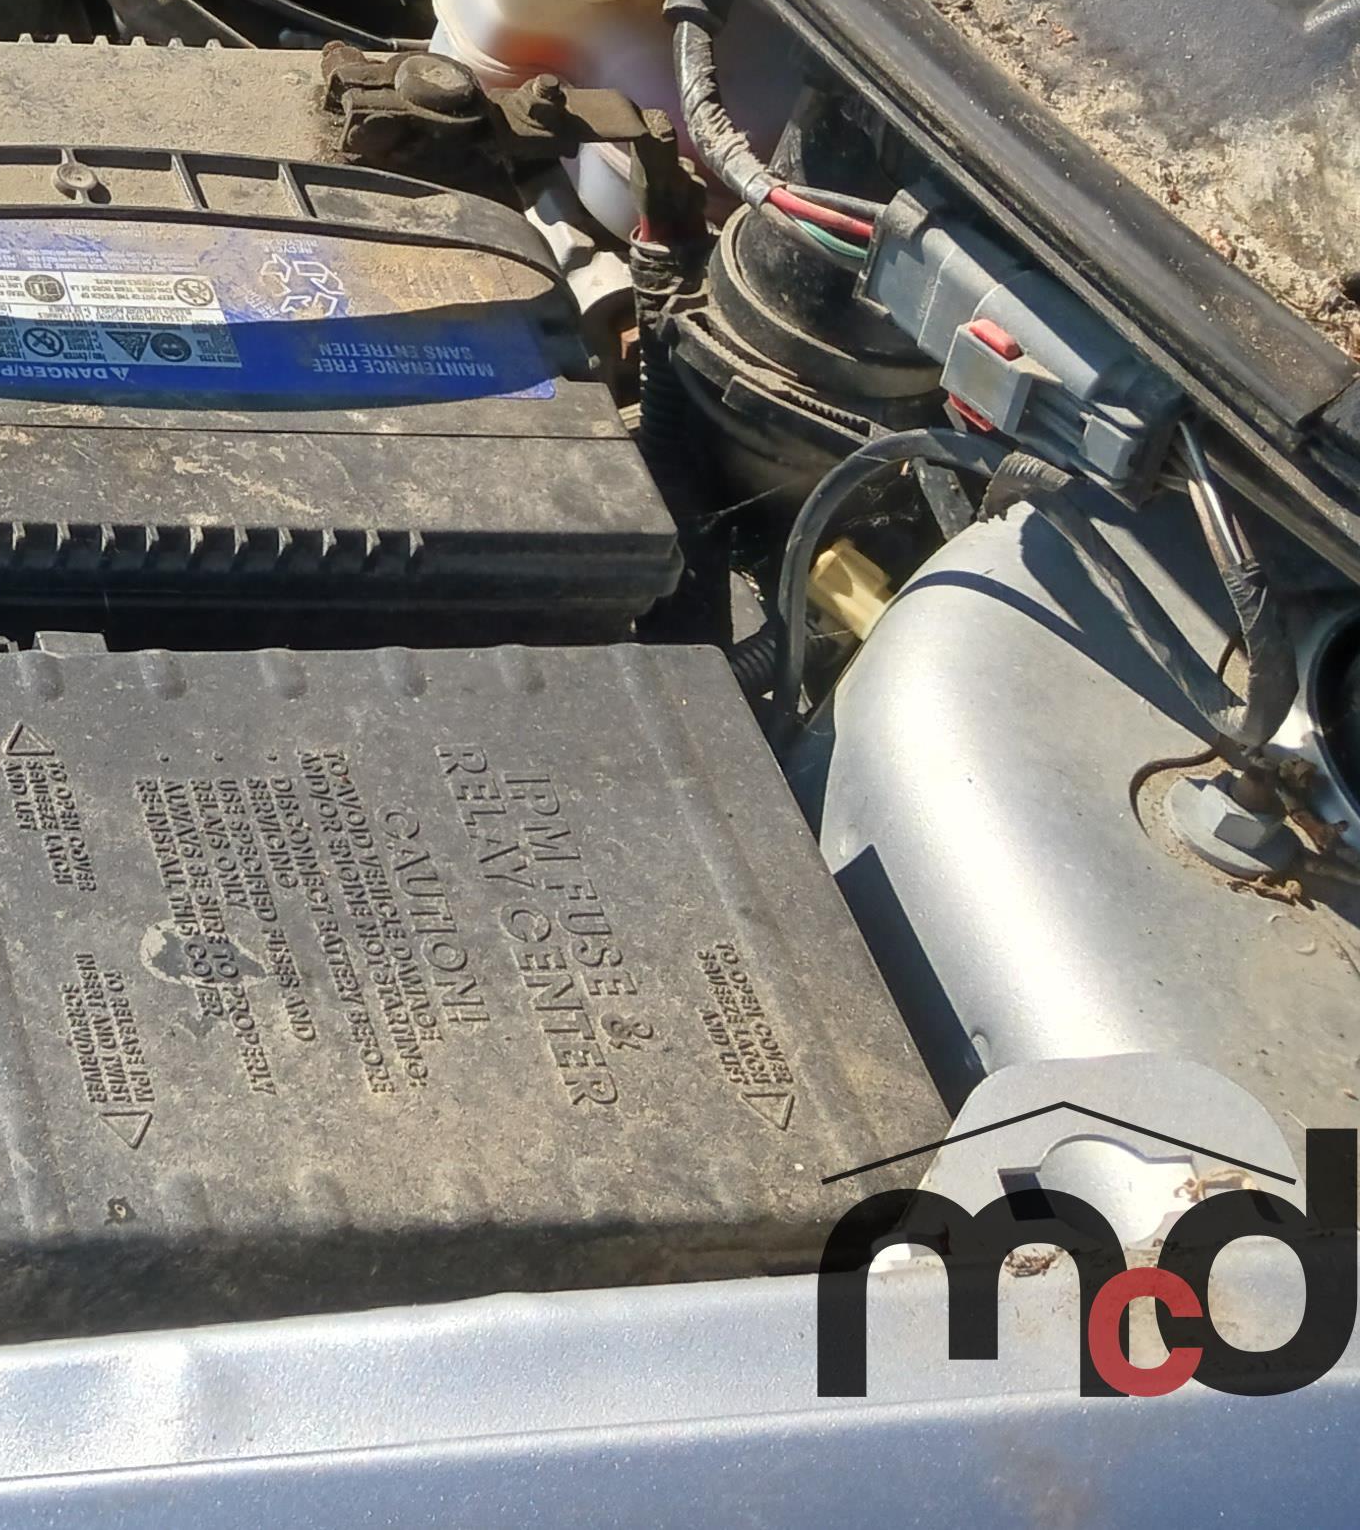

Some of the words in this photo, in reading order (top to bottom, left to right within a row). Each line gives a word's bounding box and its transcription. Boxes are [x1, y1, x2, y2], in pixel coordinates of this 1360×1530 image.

[311, 358, 357, 373] FREE
[318, 342, 417, 358] ENTRETIEN
[362, 359, 494, 378] MAINTENANCE
[423, 345, 471, 359] SANS
[2, 761, 28, 796] AND
[46, 762, 68, 783] TO
[323, 749, 348, 778] TO
[25, 760, 59, 831] SQUEEZE
[43, 835, 73, 885] LATCH
[55, 787, 81, 832] OPEN
[162, 780, 204, 859] ALWAYS
[190, 780, 234, 849] RELAYS
[219, 779, 246, 815] USE
[333, 781, 374, 849] AVOID
[504, 771, 582, 863] IPM
[246, 778, 299, 890] SERVICING
[297, 752, 343, 833] AND/OR
[327, 839, 370, 918] ENGINE
[354, 924, 389, 967] NOT
[69, 836, 97, 892] COVER
[188, 865, 210, 890] BE
[210, 856, 250, 911] ONLY
[228, 821, 278, 923] SPECIFIED
[134, 779, 183, 890] RE-INSTALL
[168, 895, 200, 938] THIS
[184, 942, 225, 1020] COVER
[197, 895, 229, 945] SURE
[360, 856, 407, 940] VEHICLE
[376, 807, 491, 1024] CAUTION!
[269, 777, 333, 915] DISCONNECT
[318, 921, 364, 1007] BATTERY
[348, 1011, 394, 1095] BEFORE
[436, 746, 536, 889] RELAY
[500, 903, 620, 1107] CENTER
[542, 876, 638, 996] FUSE
[75, 953, 106, 1009] INSERT
[104, 971, 125, 992] TO
[214, 951, 240, 980] TO
[262, 928, 300, 989] FUSES
[284, 995, 317, 1043] AND
[392, 946, 443, 1043] DAMAGE
[697, 951, 743, 1024] SQUEEZE
[733, 1030, 771, 1084] LATCH
[715, 943, 740, 965] TO
[729, 971, 765, 1017] OPEN
[754, 1023, 794, 1084] COVER
[62, 983, 107, 1104] SCREWDRIVER
[91, 1014, 117, 1050] AND
[109, 997, 145, 1065] RELEASE
[222, 985, 277, 1097] PROPERLY
[601, 1015, 654, 1052] &
[698, 1008, 730, 1046] AND
[102, 1055, 132, 1104] TWIST
[129, 1071, 155, 1103] IPM
